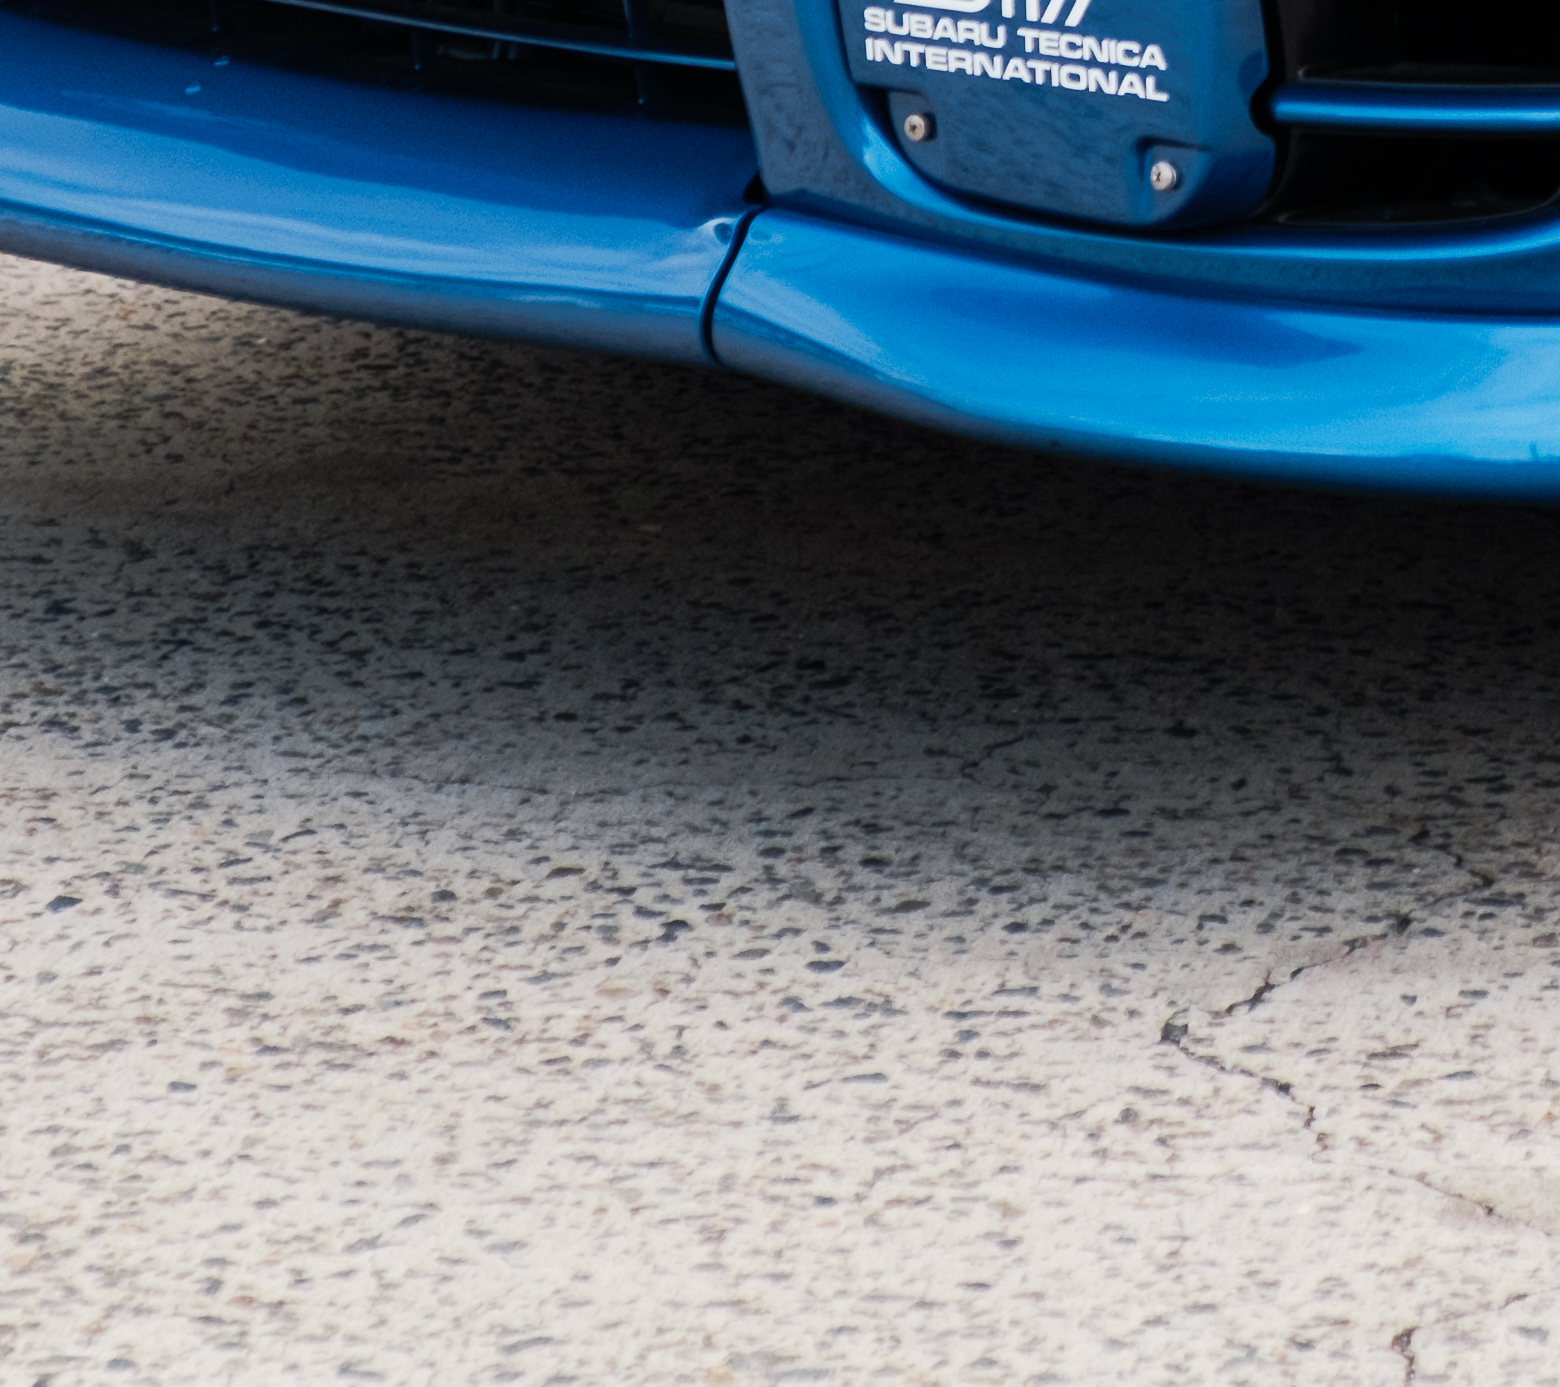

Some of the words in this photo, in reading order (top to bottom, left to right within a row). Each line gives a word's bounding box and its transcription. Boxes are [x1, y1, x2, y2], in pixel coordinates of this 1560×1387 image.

[863, 6, 1006, 49] SUBARU
[1017, 27, 1168, 71] TECNICA
[864, 37, 1170, 102] INTERNATIONAL
